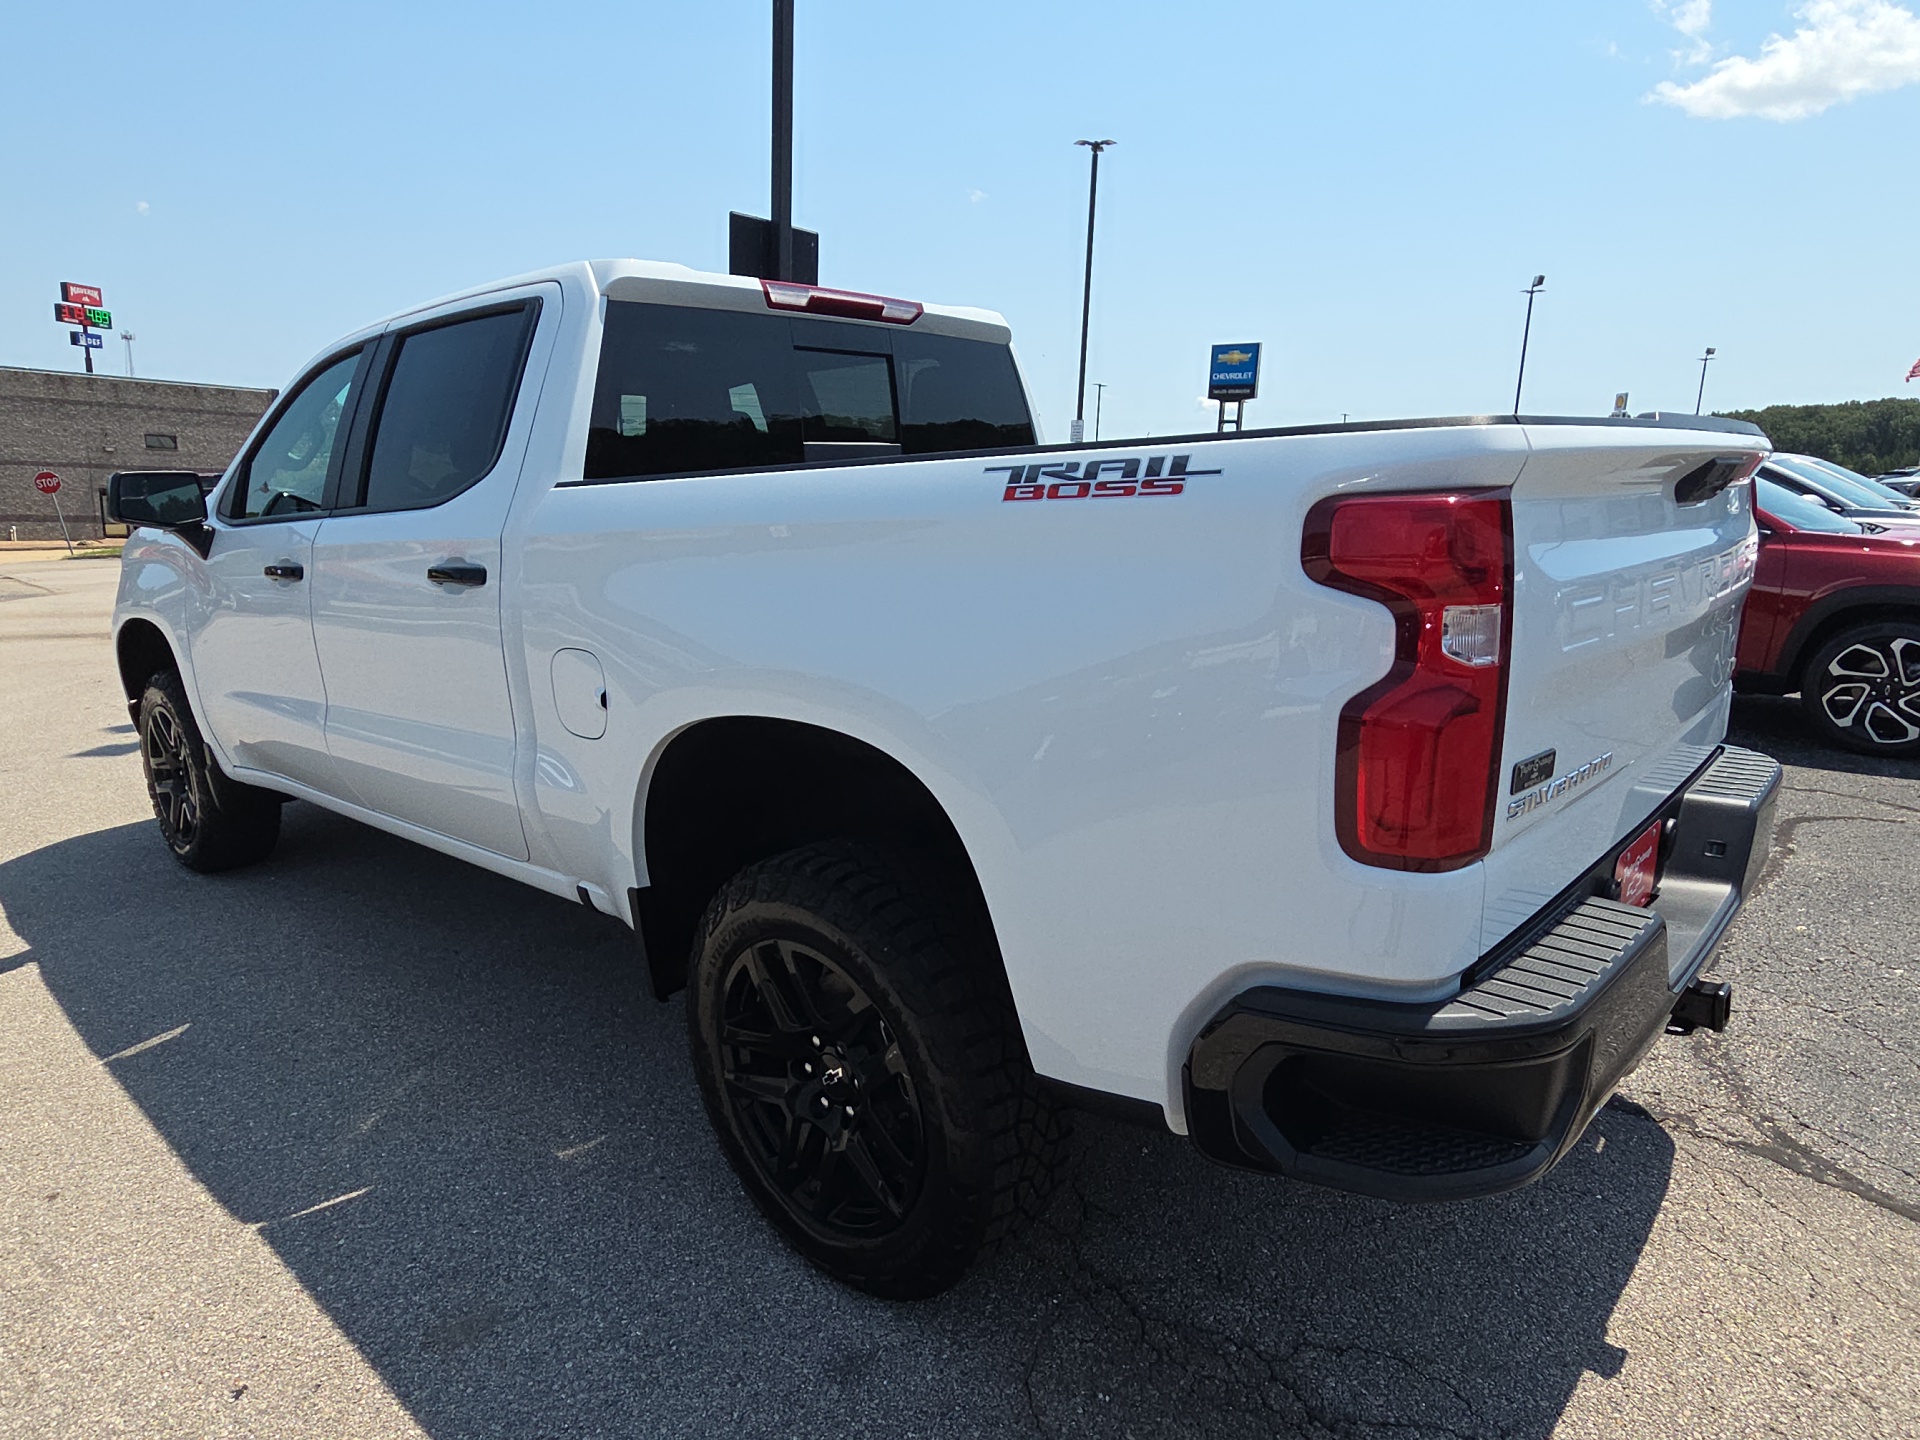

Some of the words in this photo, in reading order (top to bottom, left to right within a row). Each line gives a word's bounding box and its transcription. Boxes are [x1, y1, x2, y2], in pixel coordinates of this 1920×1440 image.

[87, 338, 101, 346] DEF
[1212, 372, 1253, 380] CHEVROLET
[984, 455, 1222, 484] TRAIL
[36, 477, 59, 489] STOP
[1002, 477, 1186, 501] BOSS
